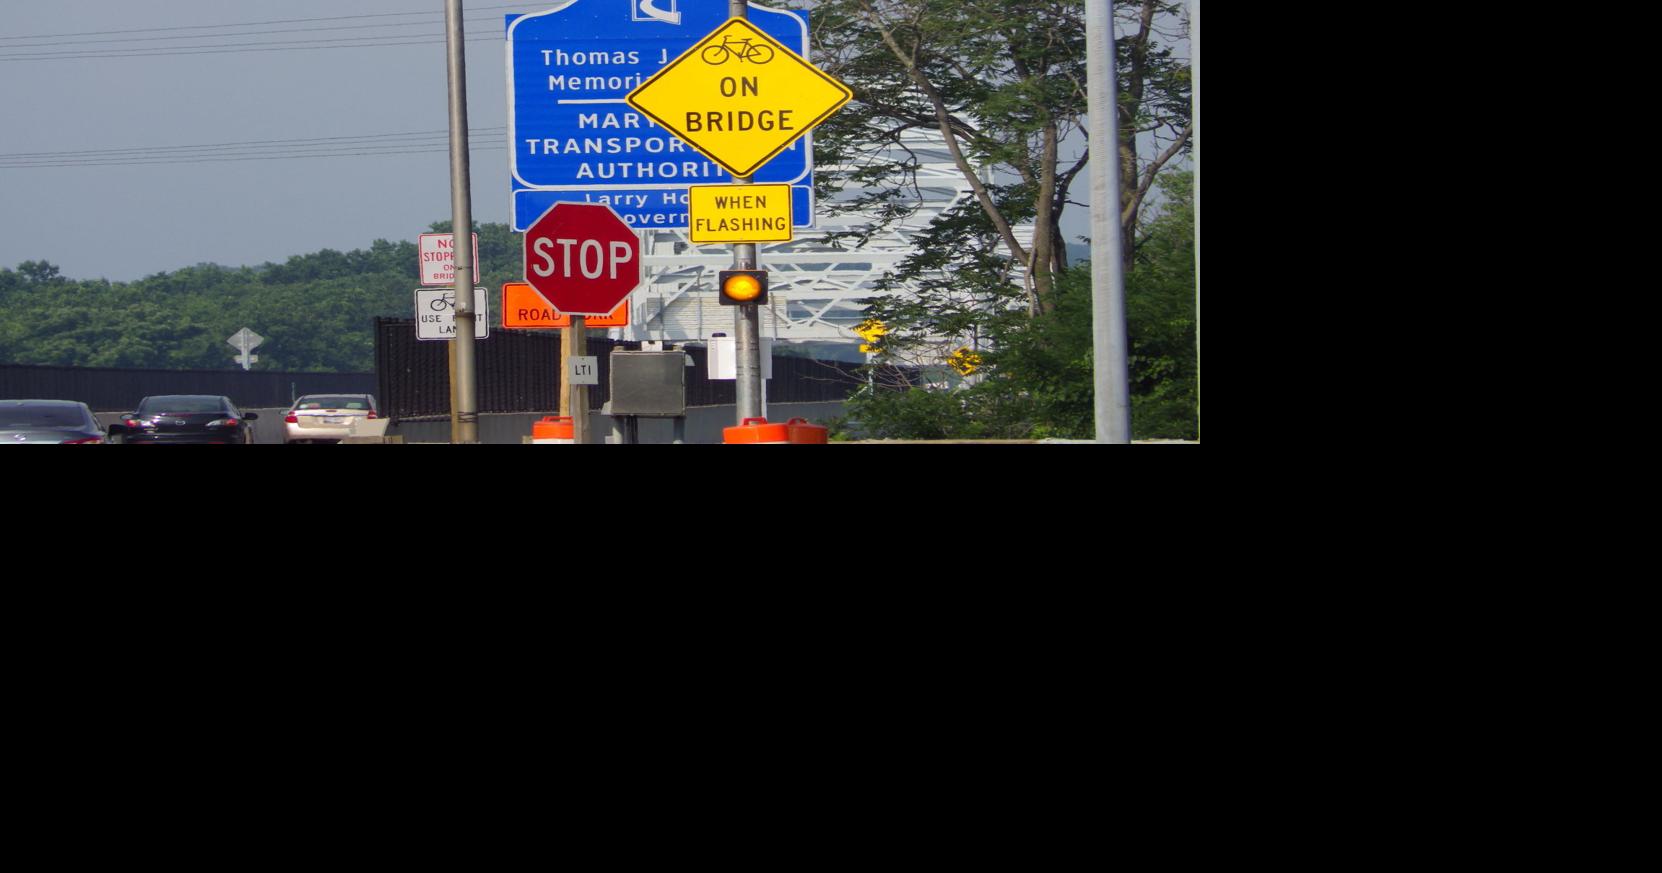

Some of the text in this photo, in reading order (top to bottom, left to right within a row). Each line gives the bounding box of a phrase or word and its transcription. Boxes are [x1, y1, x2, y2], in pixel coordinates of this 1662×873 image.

[541, 49, 640, 66] Thomas
[549, 73, 652, 91] Memori
[720, 76, 759, 97] ON
[685, 110, 794, 132] BRIDGE
[526, 137, 796, 154] TRANSPOR
[576, 161, 723, 179] AUTHORIT
[663, 192, 689, 205] Ho
[715, 195, 767, 209] WHEN
[696, 217, 786, 231] FLASHING
[423, 251, 456, 262] STOPP
[532, 237, 633, 280] STOP
[421, 314, 442, 323] USE
[518, 308, 561, 321] ROAD
[439, 325, 456, 334] LAN
